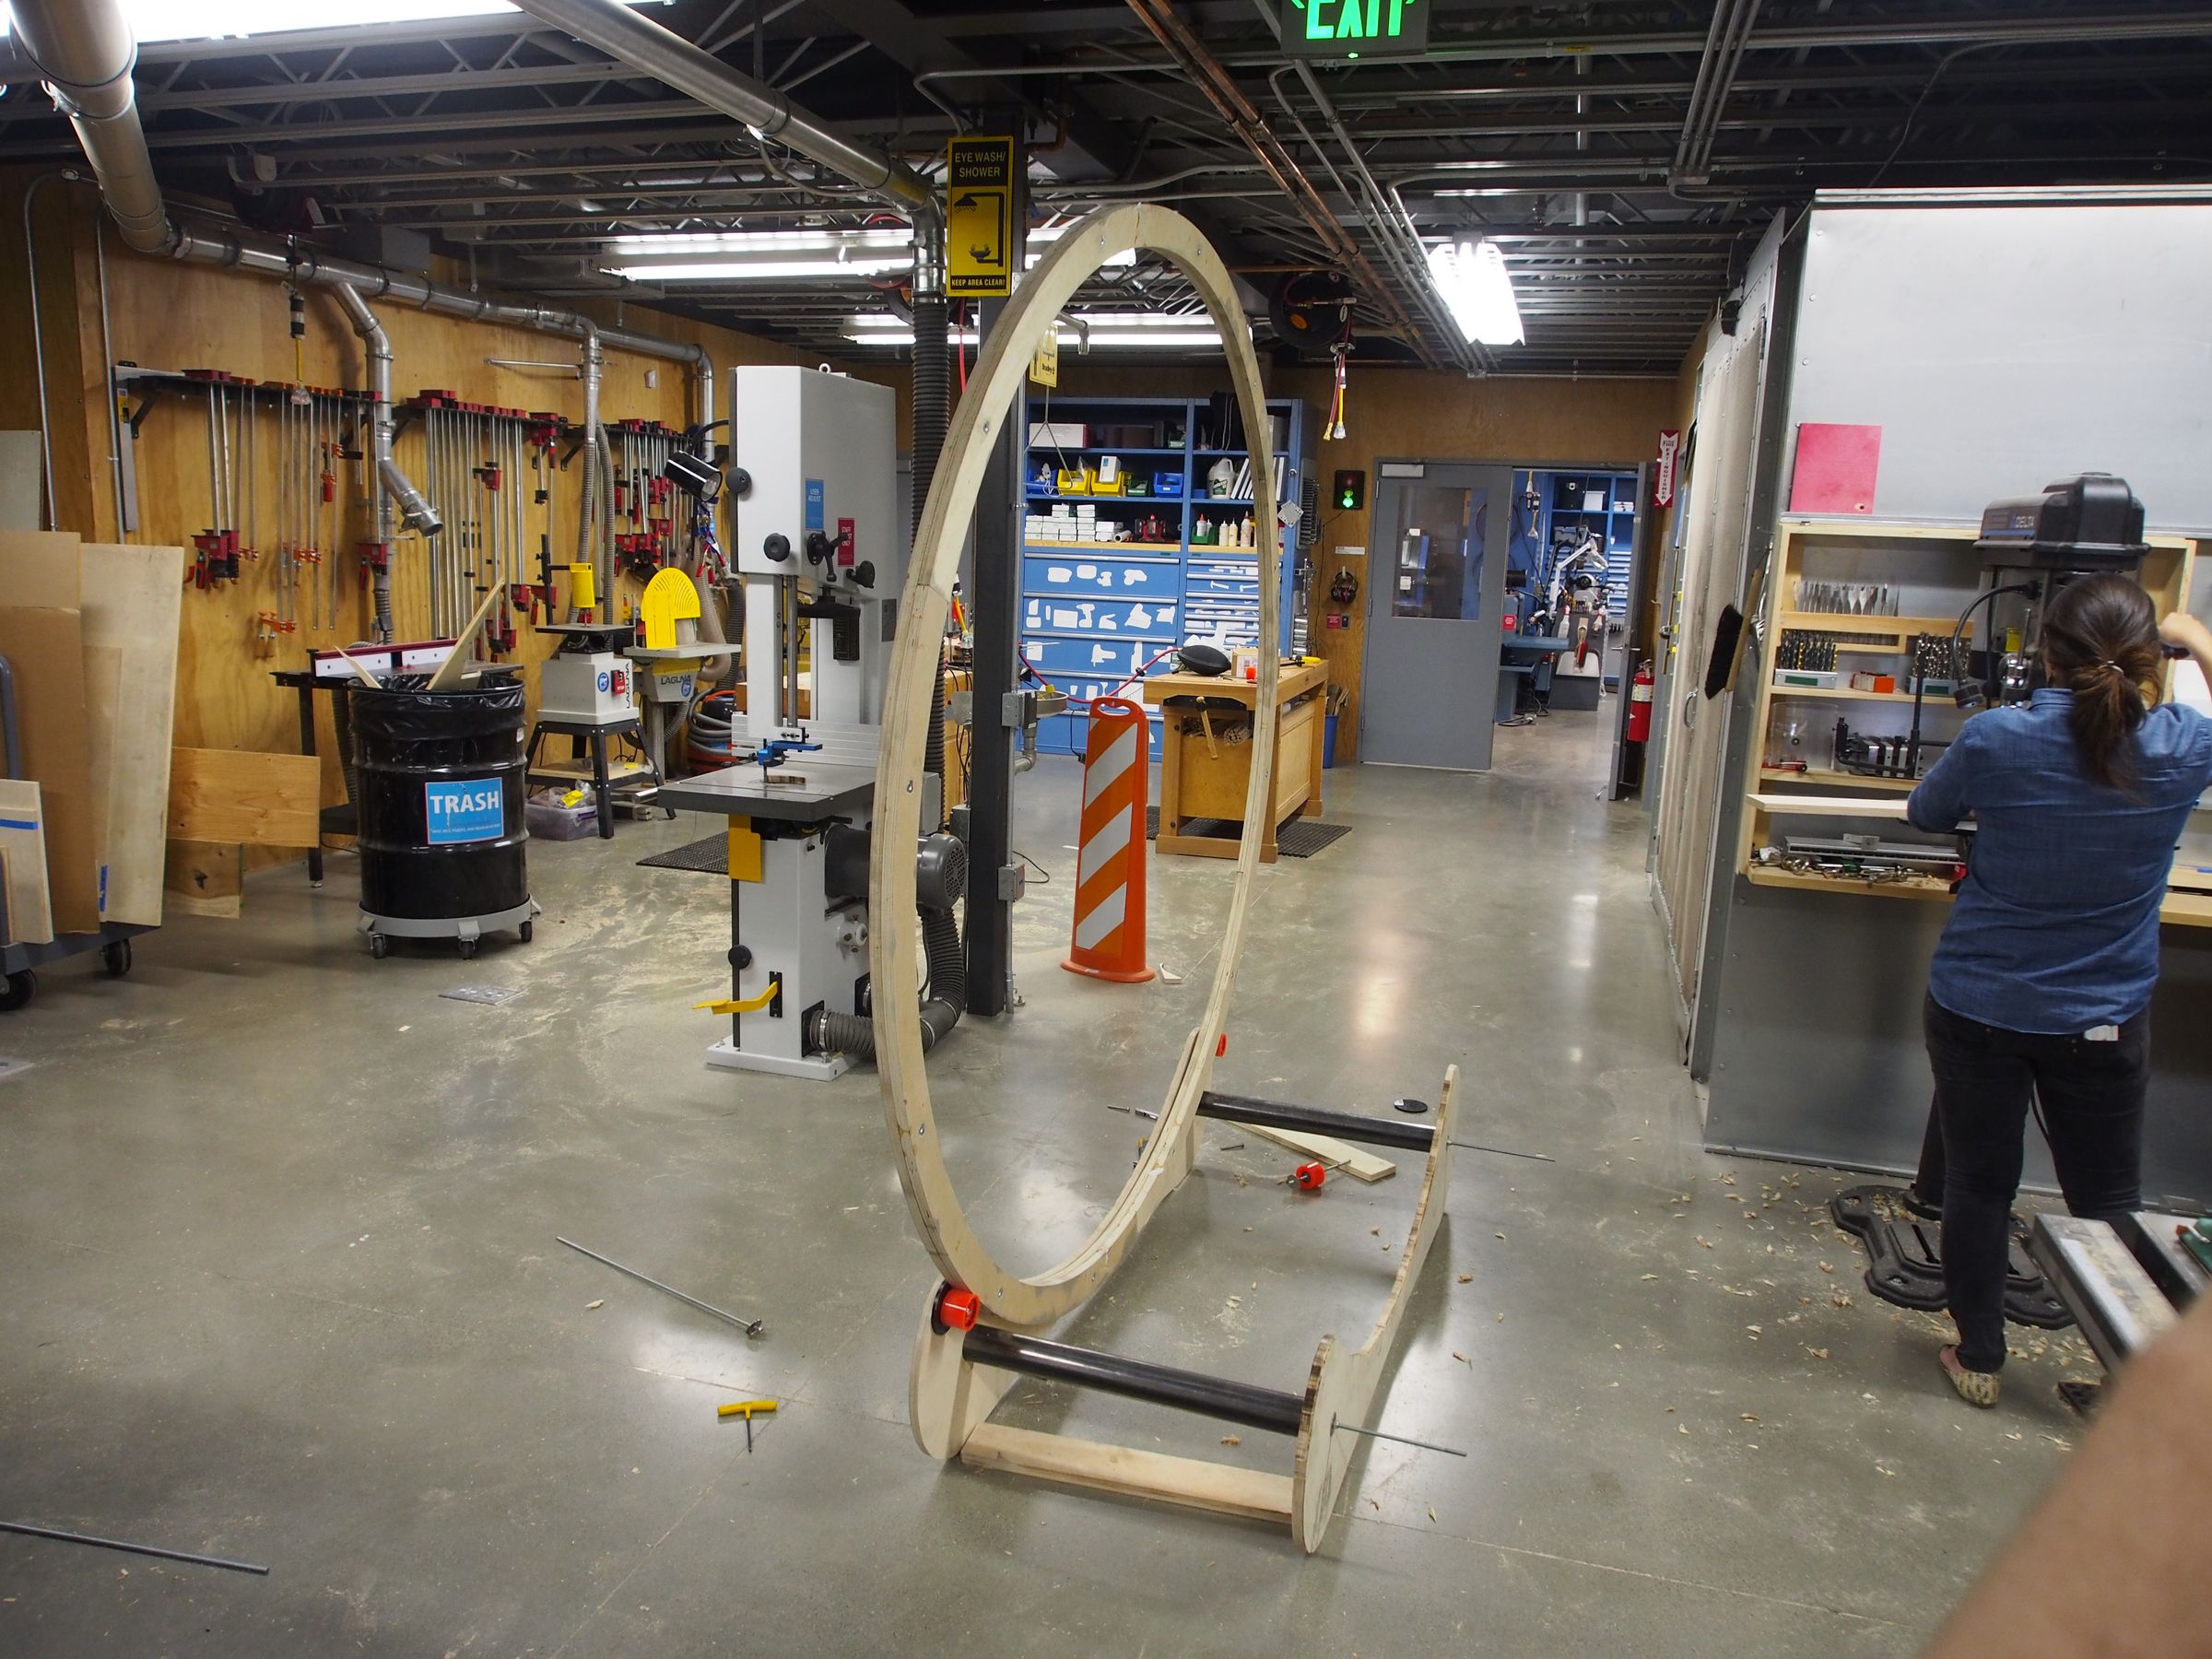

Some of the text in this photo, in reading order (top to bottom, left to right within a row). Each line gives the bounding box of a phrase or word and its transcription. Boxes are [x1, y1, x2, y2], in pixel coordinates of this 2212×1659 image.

[955, 151, 1006, 163] EYE WASH/
[959, 167, 1001, 178] SHOWER
[984, 277, 1006, 286] CLEAR!
[661, 675, 691, 685] LAGUNA
[429, 791, 500, 814] TRASH
